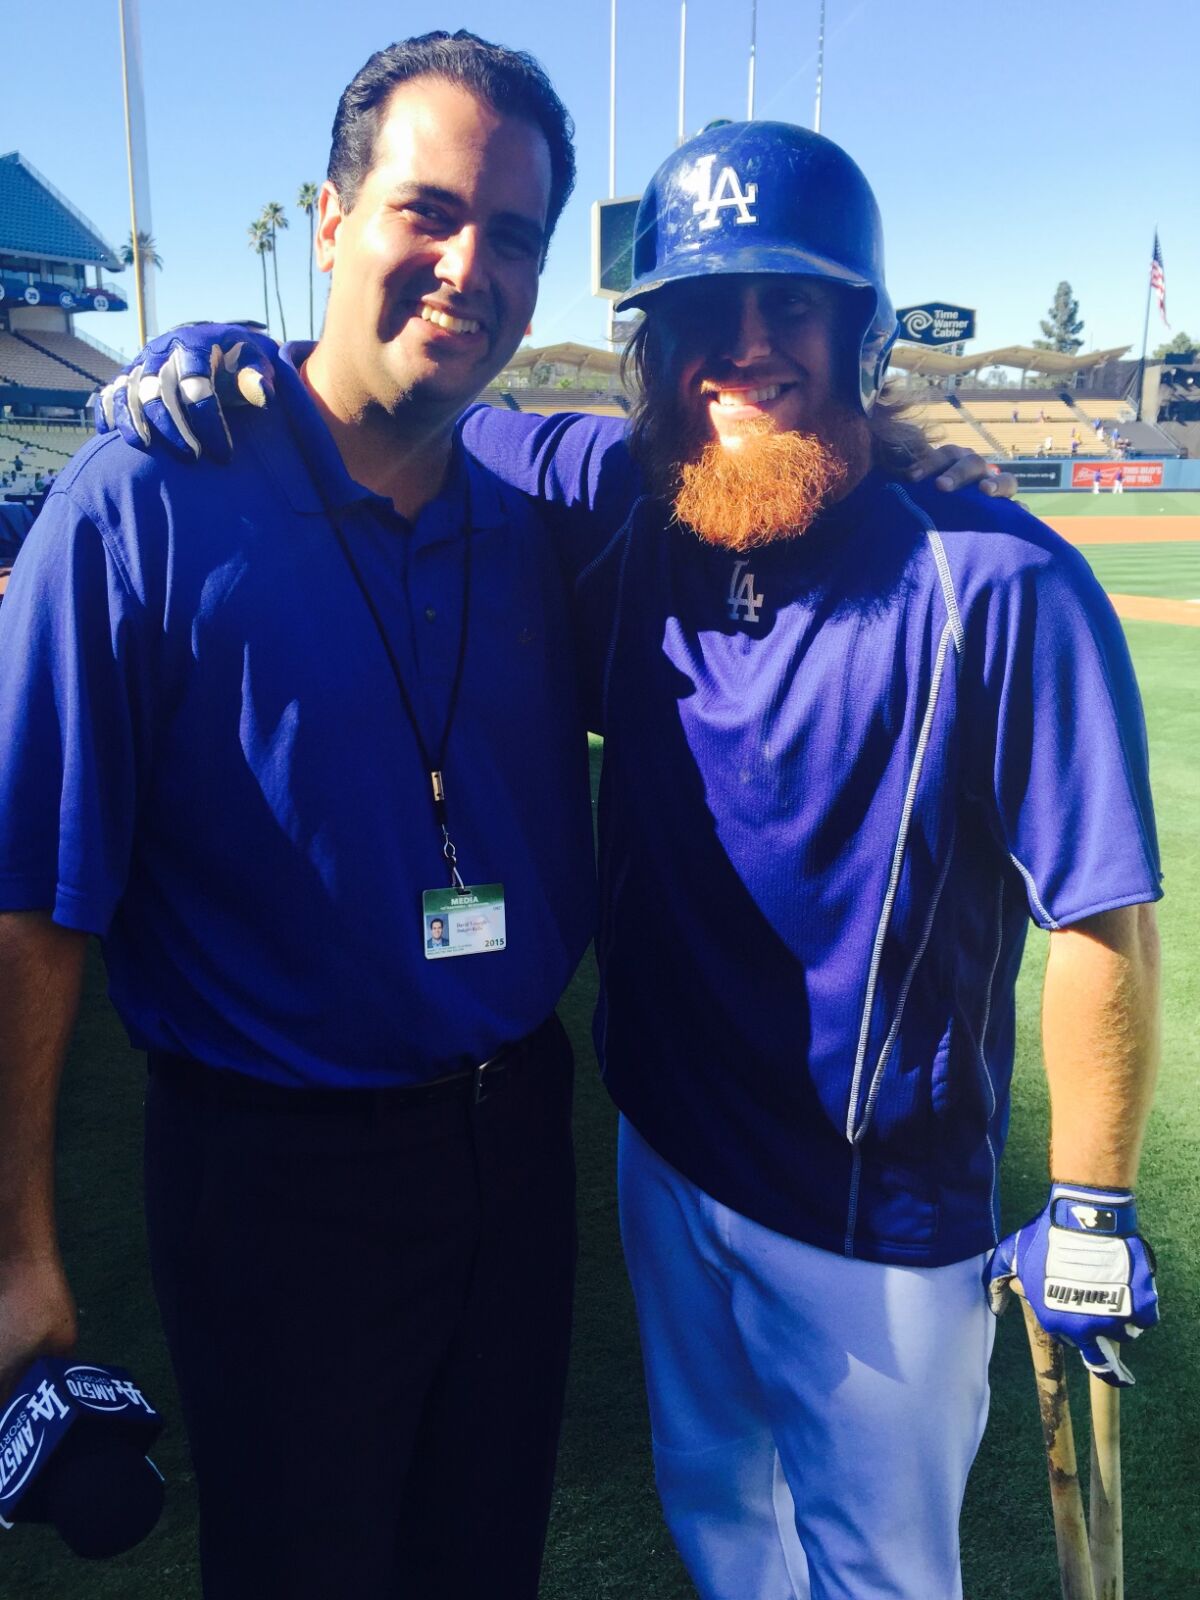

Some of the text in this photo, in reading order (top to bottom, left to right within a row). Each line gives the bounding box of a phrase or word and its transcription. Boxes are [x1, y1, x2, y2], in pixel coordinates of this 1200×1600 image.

[692, 154, 758, 232] LA
[933, 320, 969, 328] Warner
[934, 310, 959, 319] Time
[932, 329, 962, 337] Cable
[728, 560, 764, 623] LA
[451, 896, 479, 906] MEDIA
[485, 938, 504, 947] 2015
[1047, 1284, 1125, 1312] Franklin
[26, 1379, 70, 1421] LA
[66, 1379, 117, 1402] AM570
[0, 1419, 35, 1493] AM57
